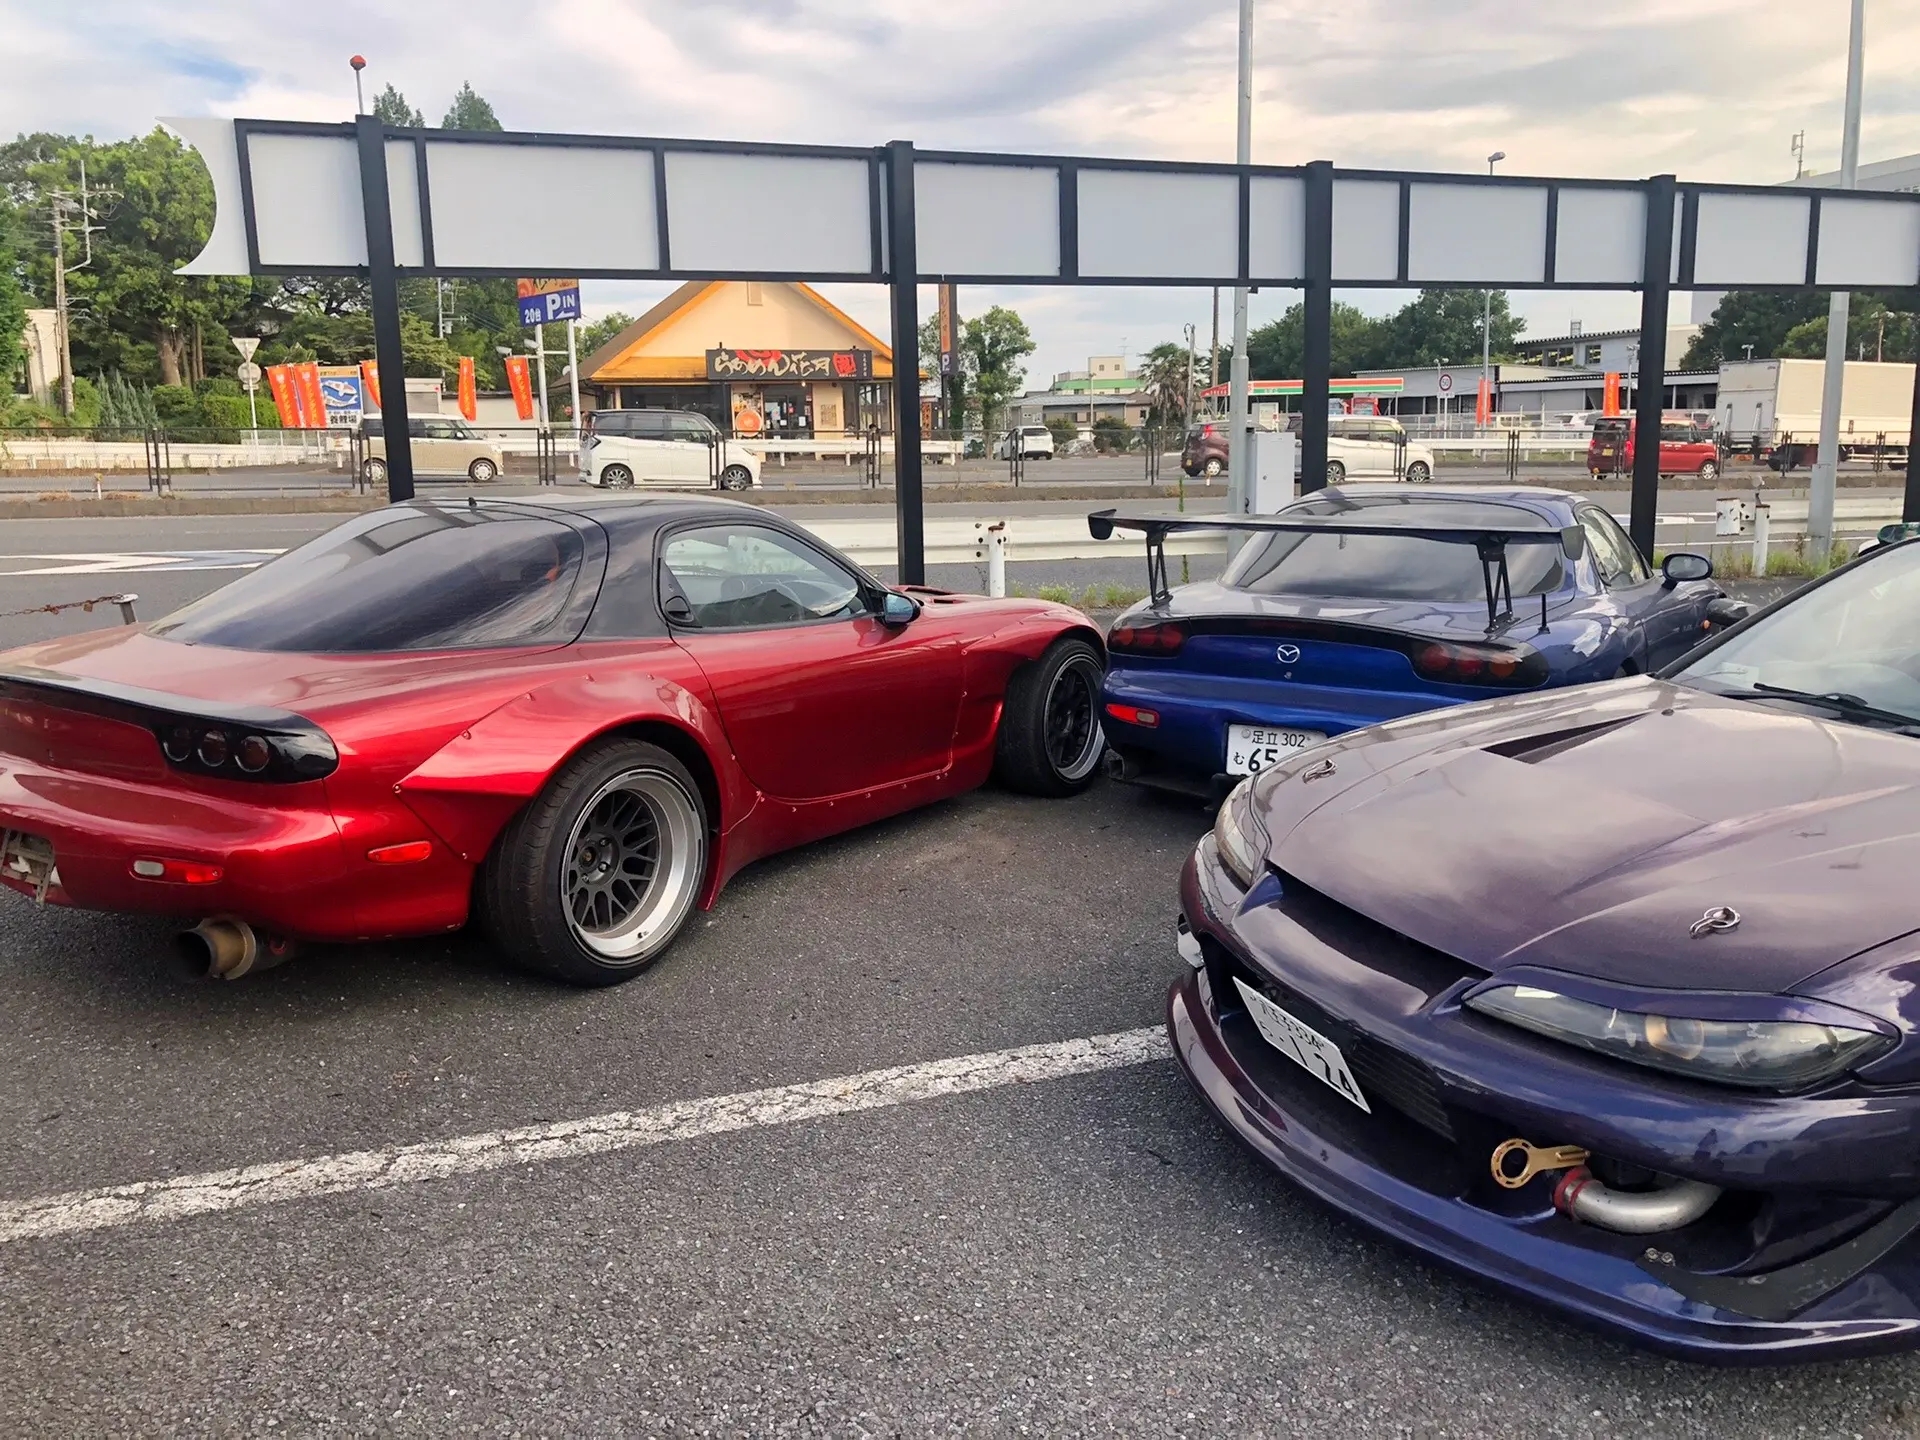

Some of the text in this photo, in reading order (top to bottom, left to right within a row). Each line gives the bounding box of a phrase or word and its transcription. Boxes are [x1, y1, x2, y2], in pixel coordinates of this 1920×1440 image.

[546, 293, 575, 320] P IN
[1251, 730, 1306, 748] 足立 302
[1233, 747, 1278, 772] む 65
